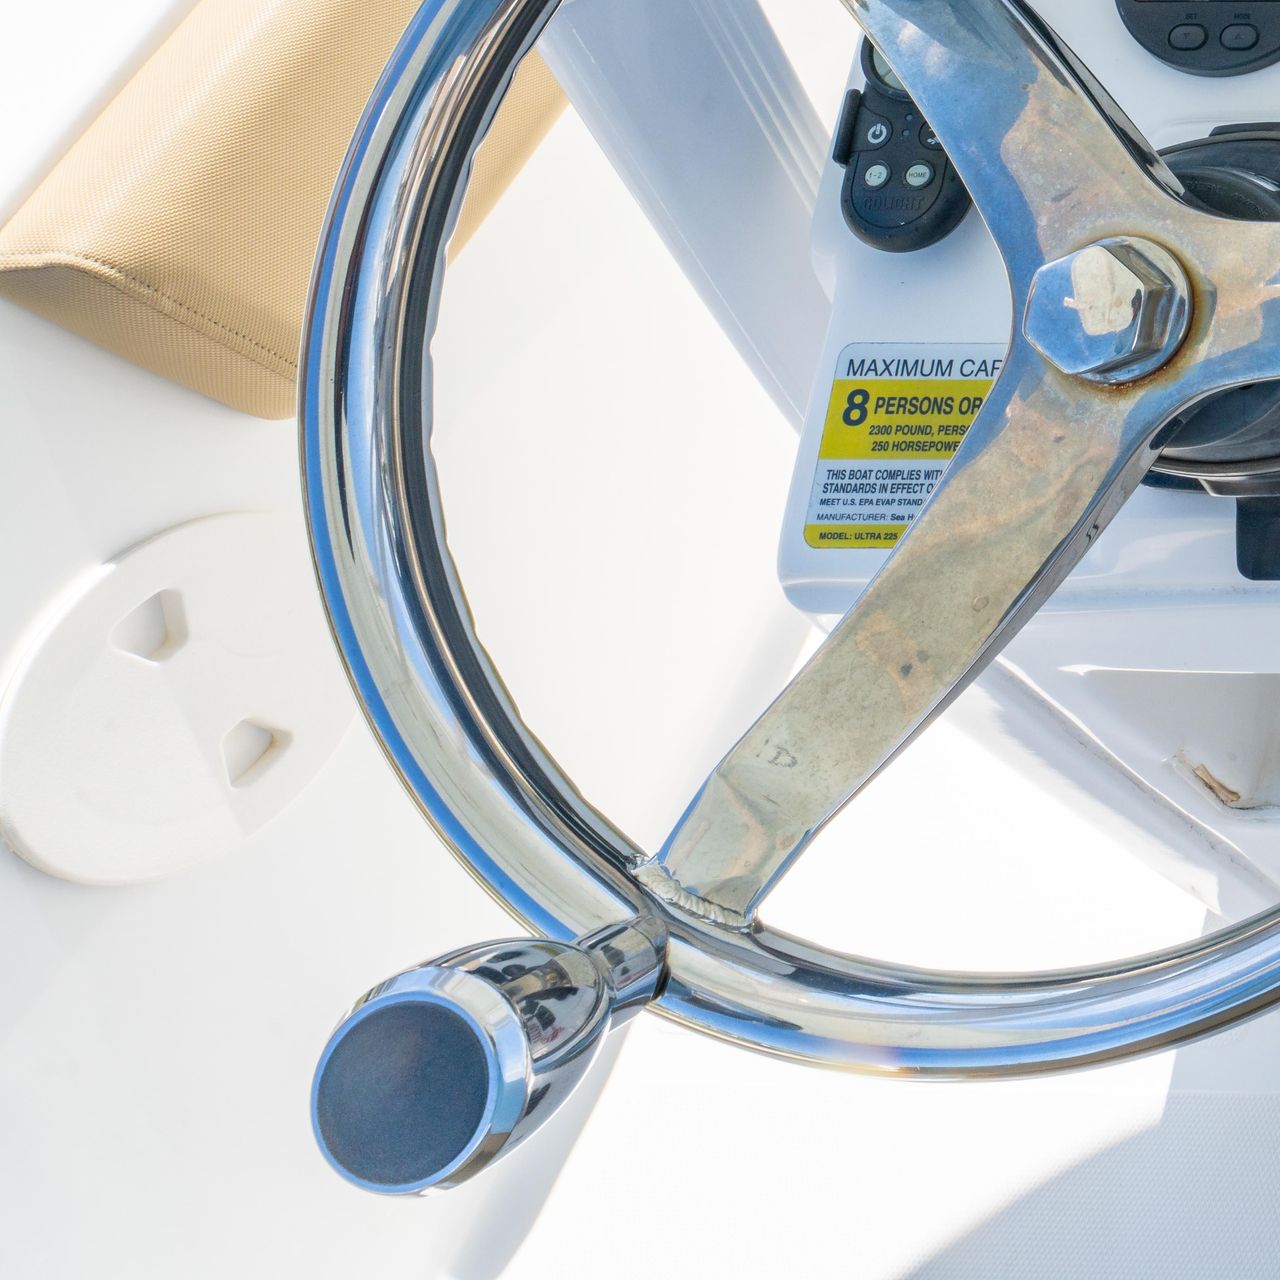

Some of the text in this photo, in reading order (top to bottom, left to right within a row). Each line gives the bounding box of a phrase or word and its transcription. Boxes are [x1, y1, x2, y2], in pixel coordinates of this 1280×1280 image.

[908, 171, 928, 179] HOME
[846, 359, 1002, 377] MAXIMUM CAP
[842, 388, 984, 427] 8 PERSONS OR
[869, 424, 970, 437] 2300 POUND, PERS
[871, 440, 961, 452] 250 HORSEPOWE
[826, 469, 847, 481] THIS
[848, 469, 873, 481] BOAT
[875, 469, 922, 481] COMPLIES
[822, 483, 935, 494] STANDARDS IN EFFECT O
[819, 498, 924, 506] MEET U.S. EPA EVAP STAND
[816, 513, 889, 522] MANUFACTURER:
[890, 513, 906, 521] Sea
[819, 532, 898, 540] MODEL: ULTRA 225
